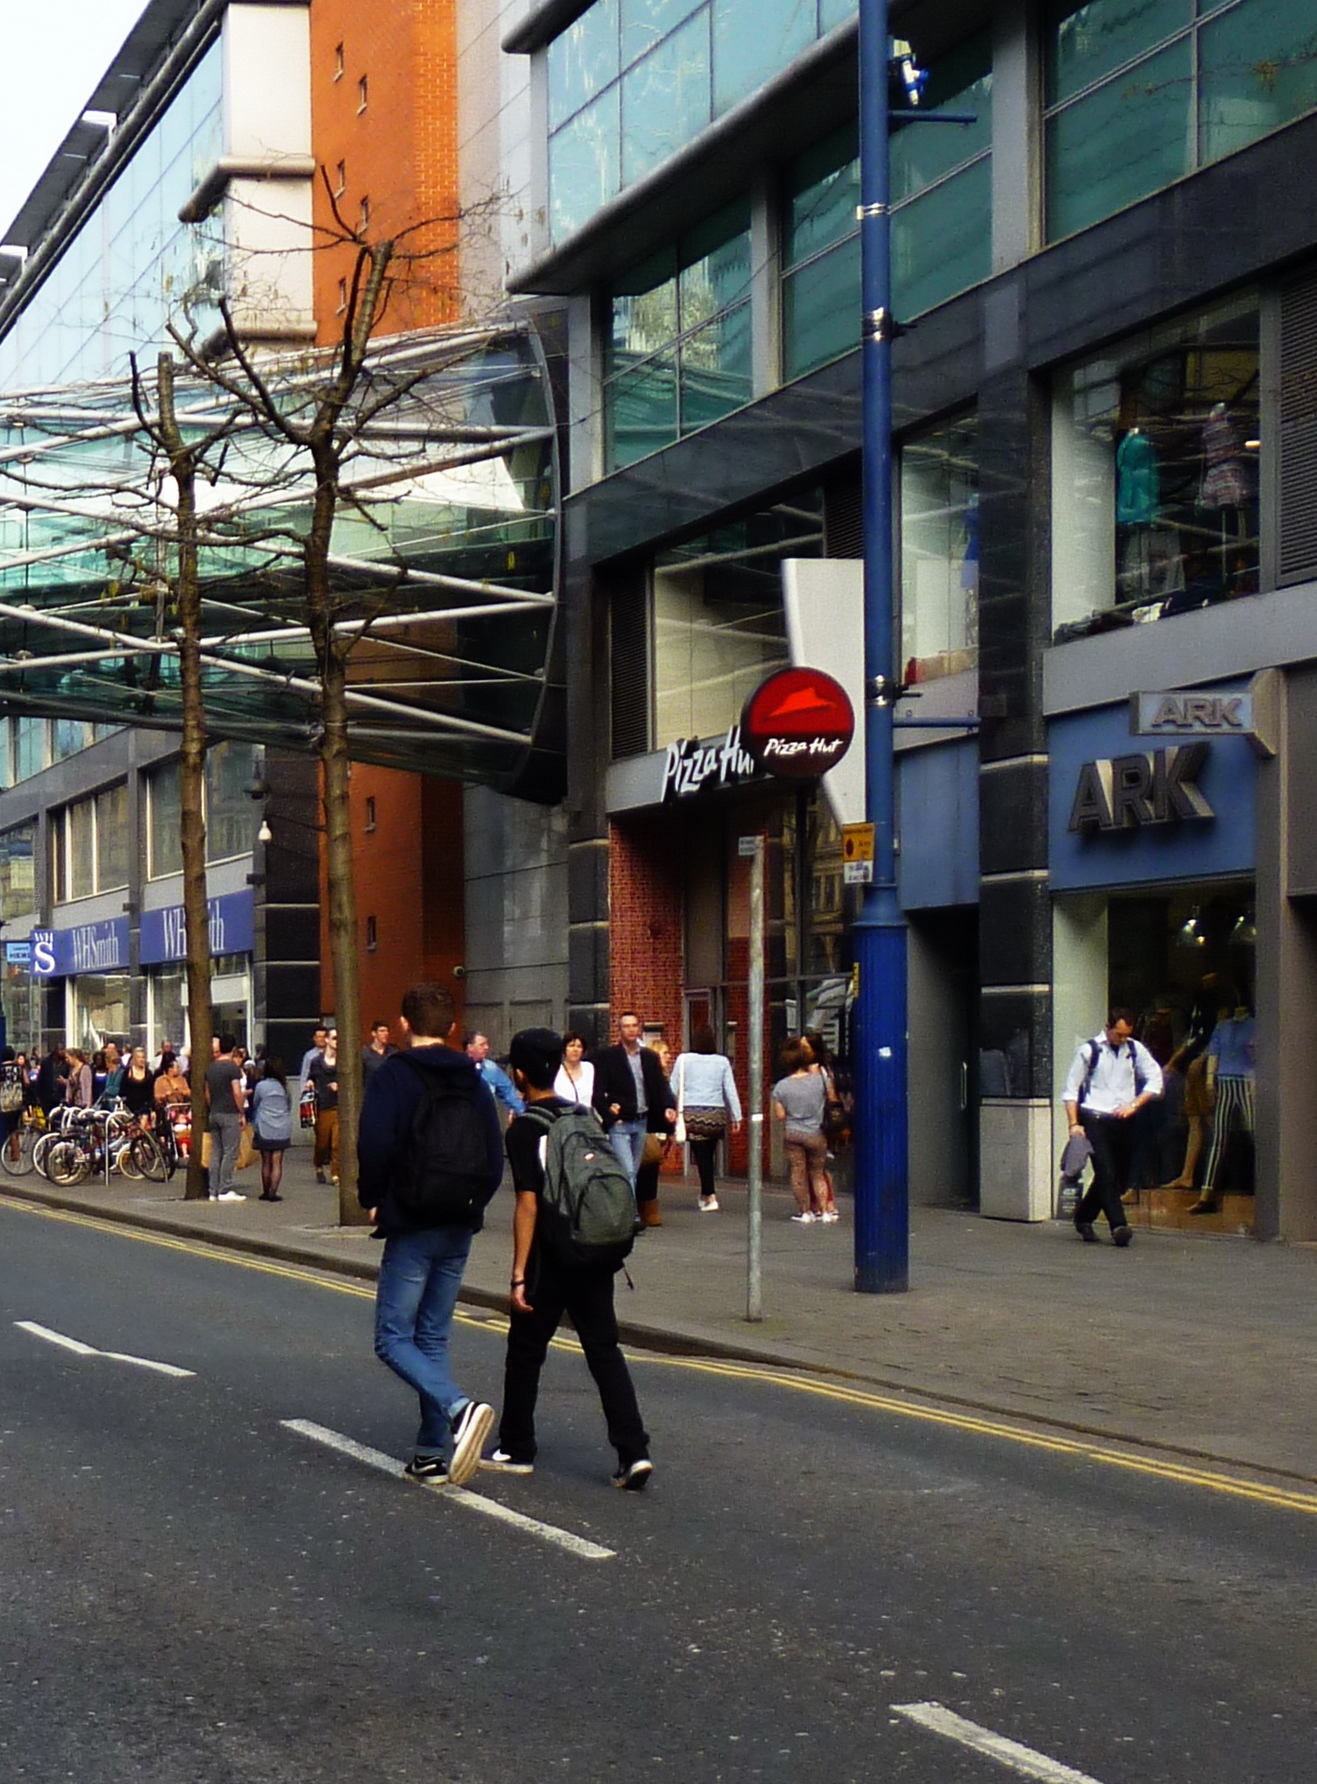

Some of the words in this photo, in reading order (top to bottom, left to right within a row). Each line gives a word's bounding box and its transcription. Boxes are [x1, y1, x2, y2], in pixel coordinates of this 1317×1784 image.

[1151, 697, 1242, 727] ARK
[763, 738, 808, 756] Pizza
[809, 737, 844, 755] Hut
[661, 739, 717, 802] Pizza
[1068, 741, 1215, 832] ARK
[34, 941, 56, 973] S
[72, 921, 119, 970] WHSmith
